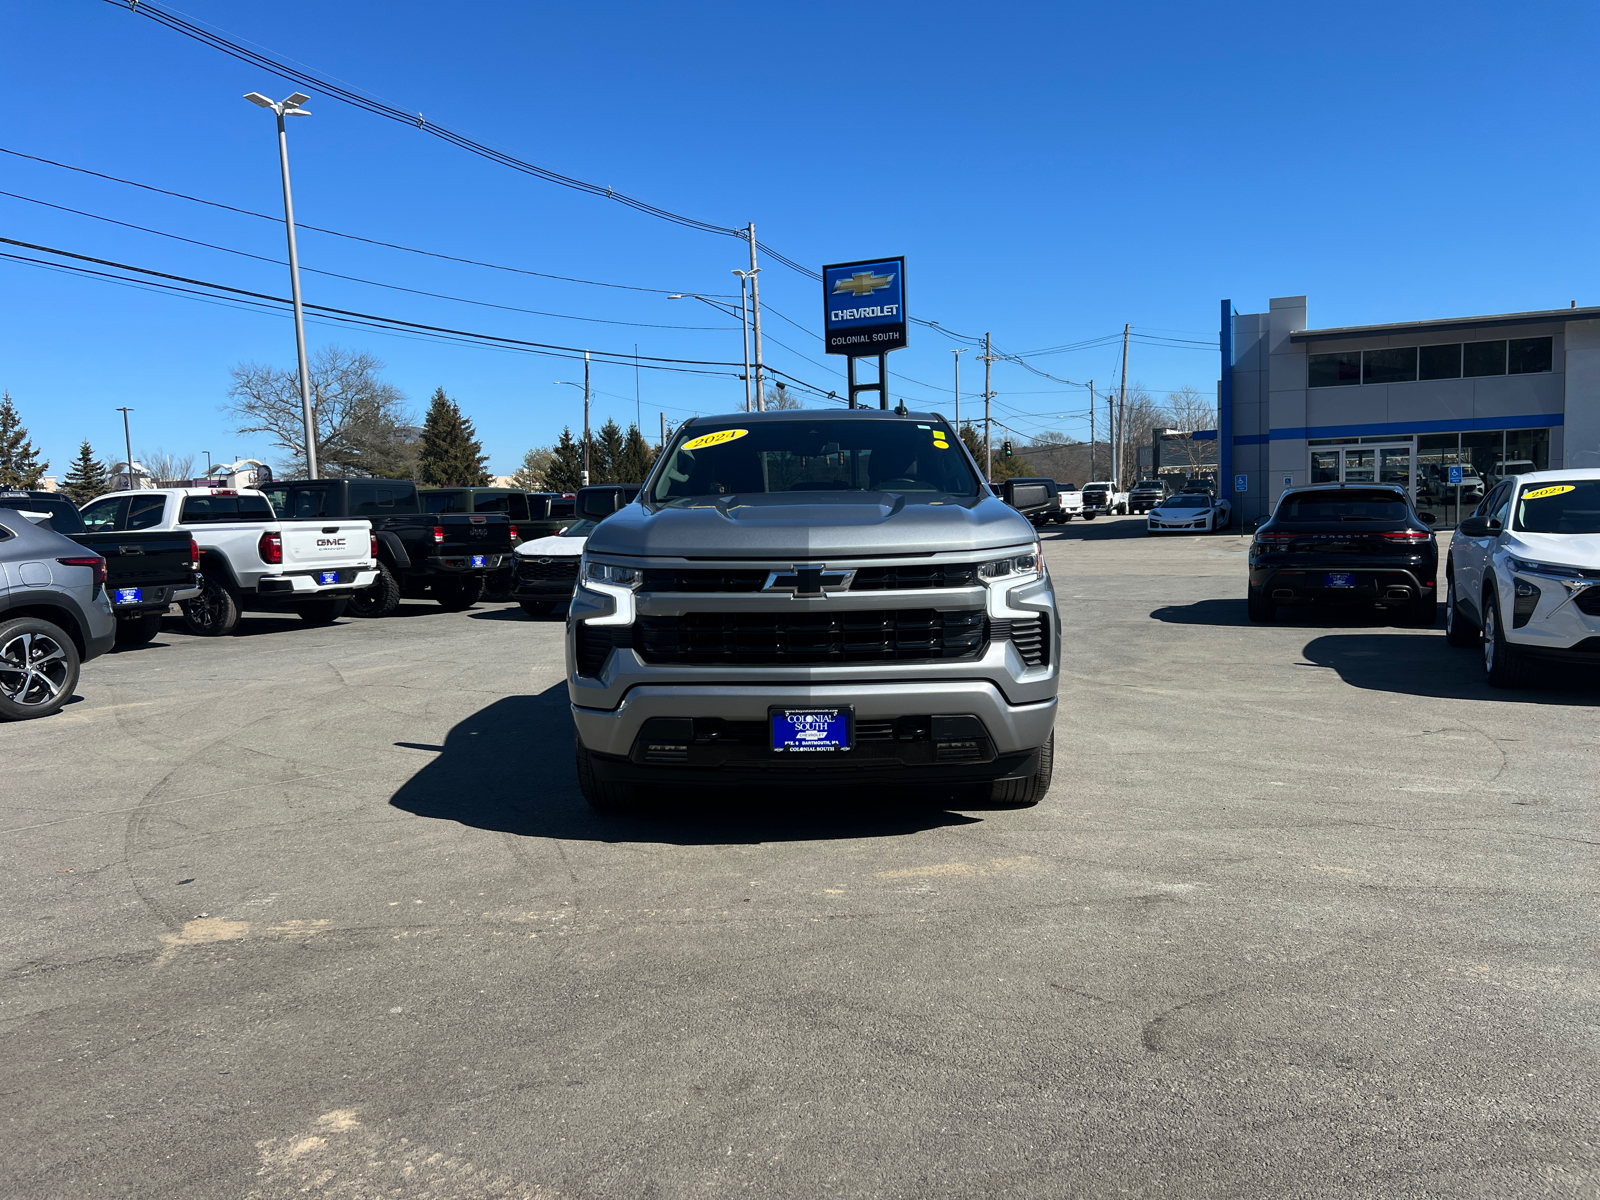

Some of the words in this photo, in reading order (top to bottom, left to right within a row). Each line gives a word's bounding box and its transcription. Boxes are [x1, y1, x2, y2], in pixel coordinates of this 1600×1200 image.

[831, 304, 899, 321] CHEVROLET
[831, 334, 870, 346] COLONIAL
[872, 331, 900, 342] SOUTH
[693, 430, 737, 448] 2024
[1531, 486, 1565, 498] 2024
[316, 538, 346, 546] GMC
[787, 715, 835, 723] COLONIAL
[794, 723, 828, 731] SOUTH
